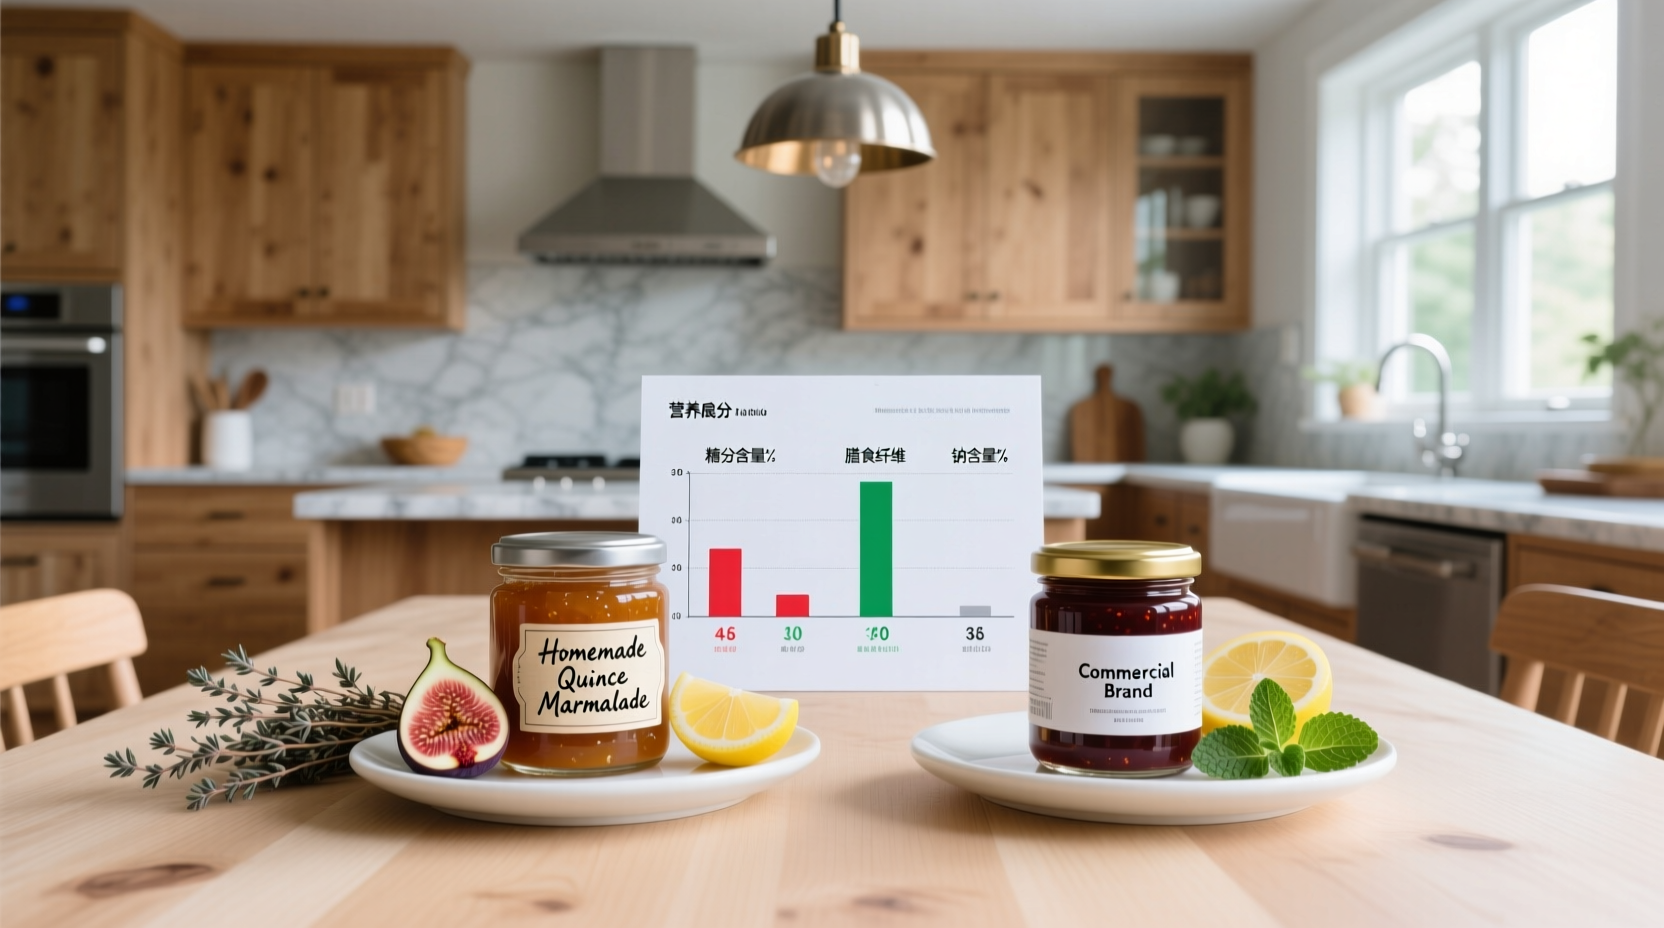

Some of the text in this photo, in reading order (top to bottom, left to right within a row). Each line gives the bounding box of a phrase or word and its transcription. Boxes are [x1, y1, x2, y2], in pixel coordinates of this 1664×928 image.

[538, 635, 647, 665] Homemade
[558, 665, 628, 693] Quince
[1079, 662, 1174, 680] Commercial
[537, 687, 650, 717] Marmalade
[1104, 683, 1153, 698] Brand
